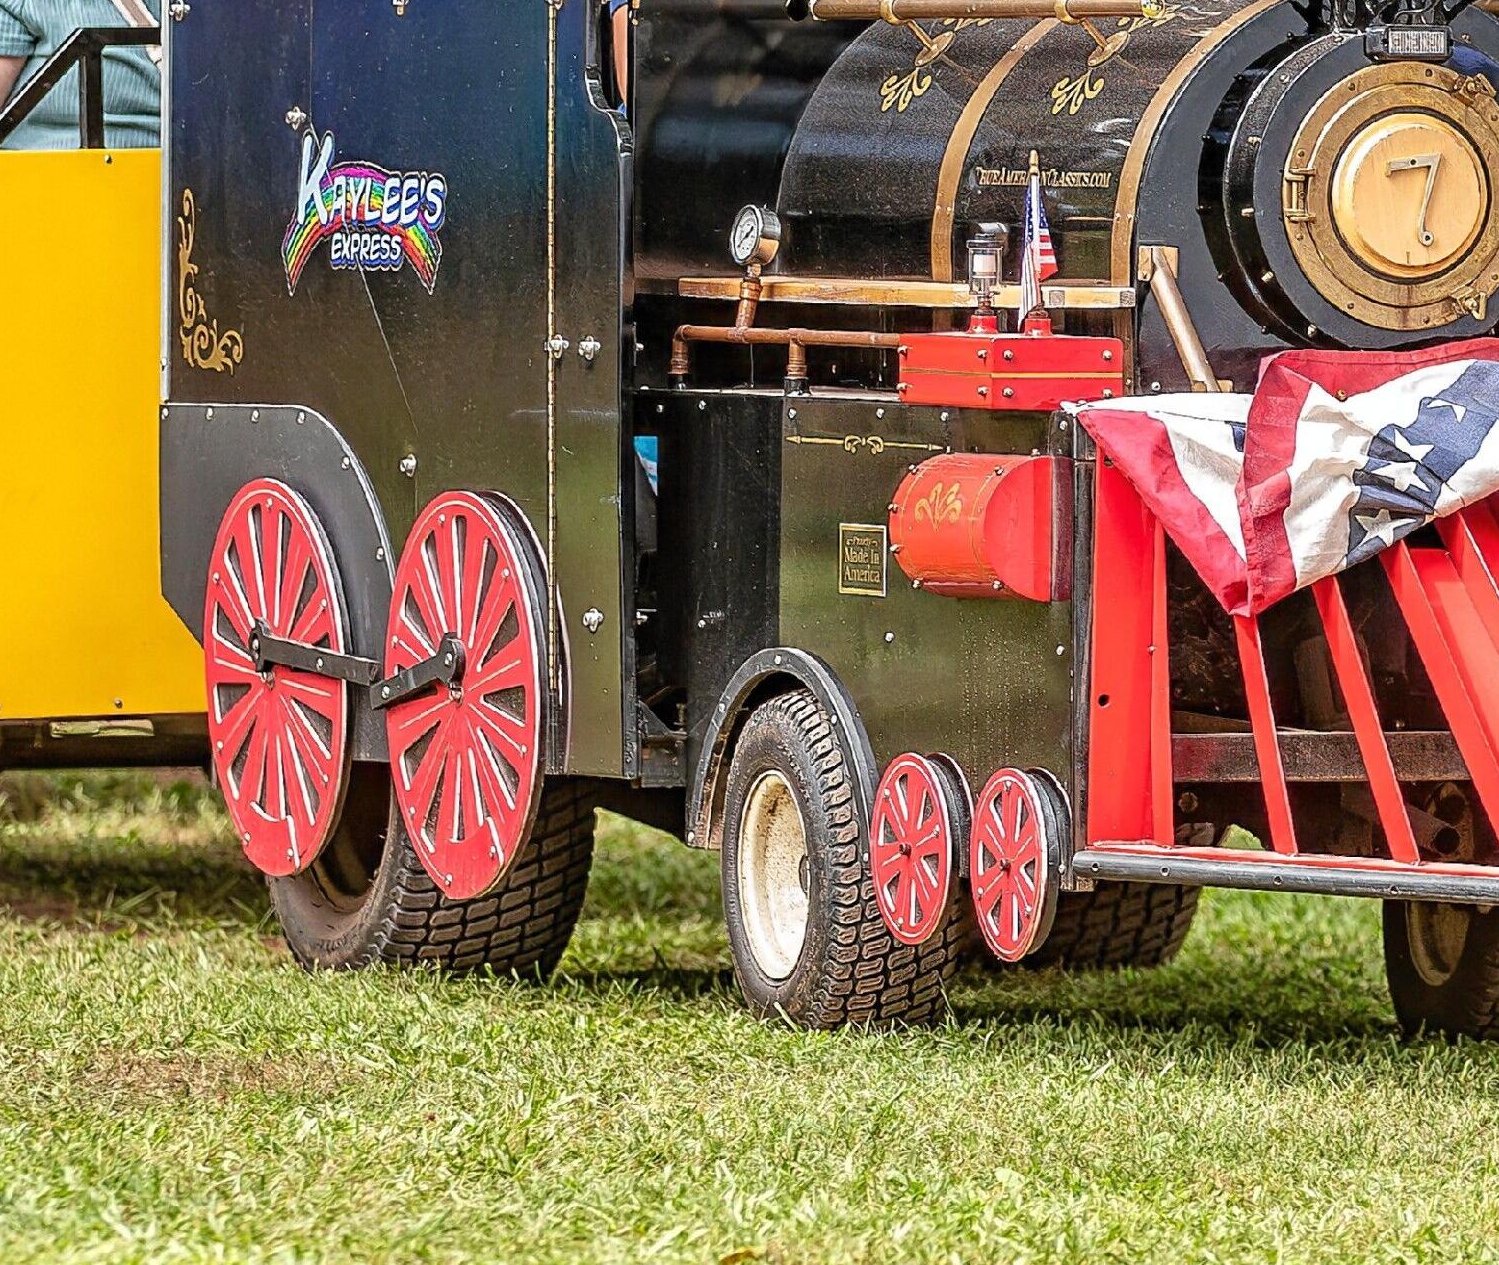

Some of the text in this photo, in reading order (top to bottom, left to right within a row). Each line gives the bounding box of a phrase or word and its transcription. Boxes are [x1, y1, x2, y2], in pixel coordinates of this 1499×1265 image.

[297, 133, 445, 227] KAYLEE'S
[1386, 153, 1443, 247] 7
[330, 232, 402, 265] EXPRESS
[844, 546, 880, 565] Made In
[844, 564, 881, 583] America
